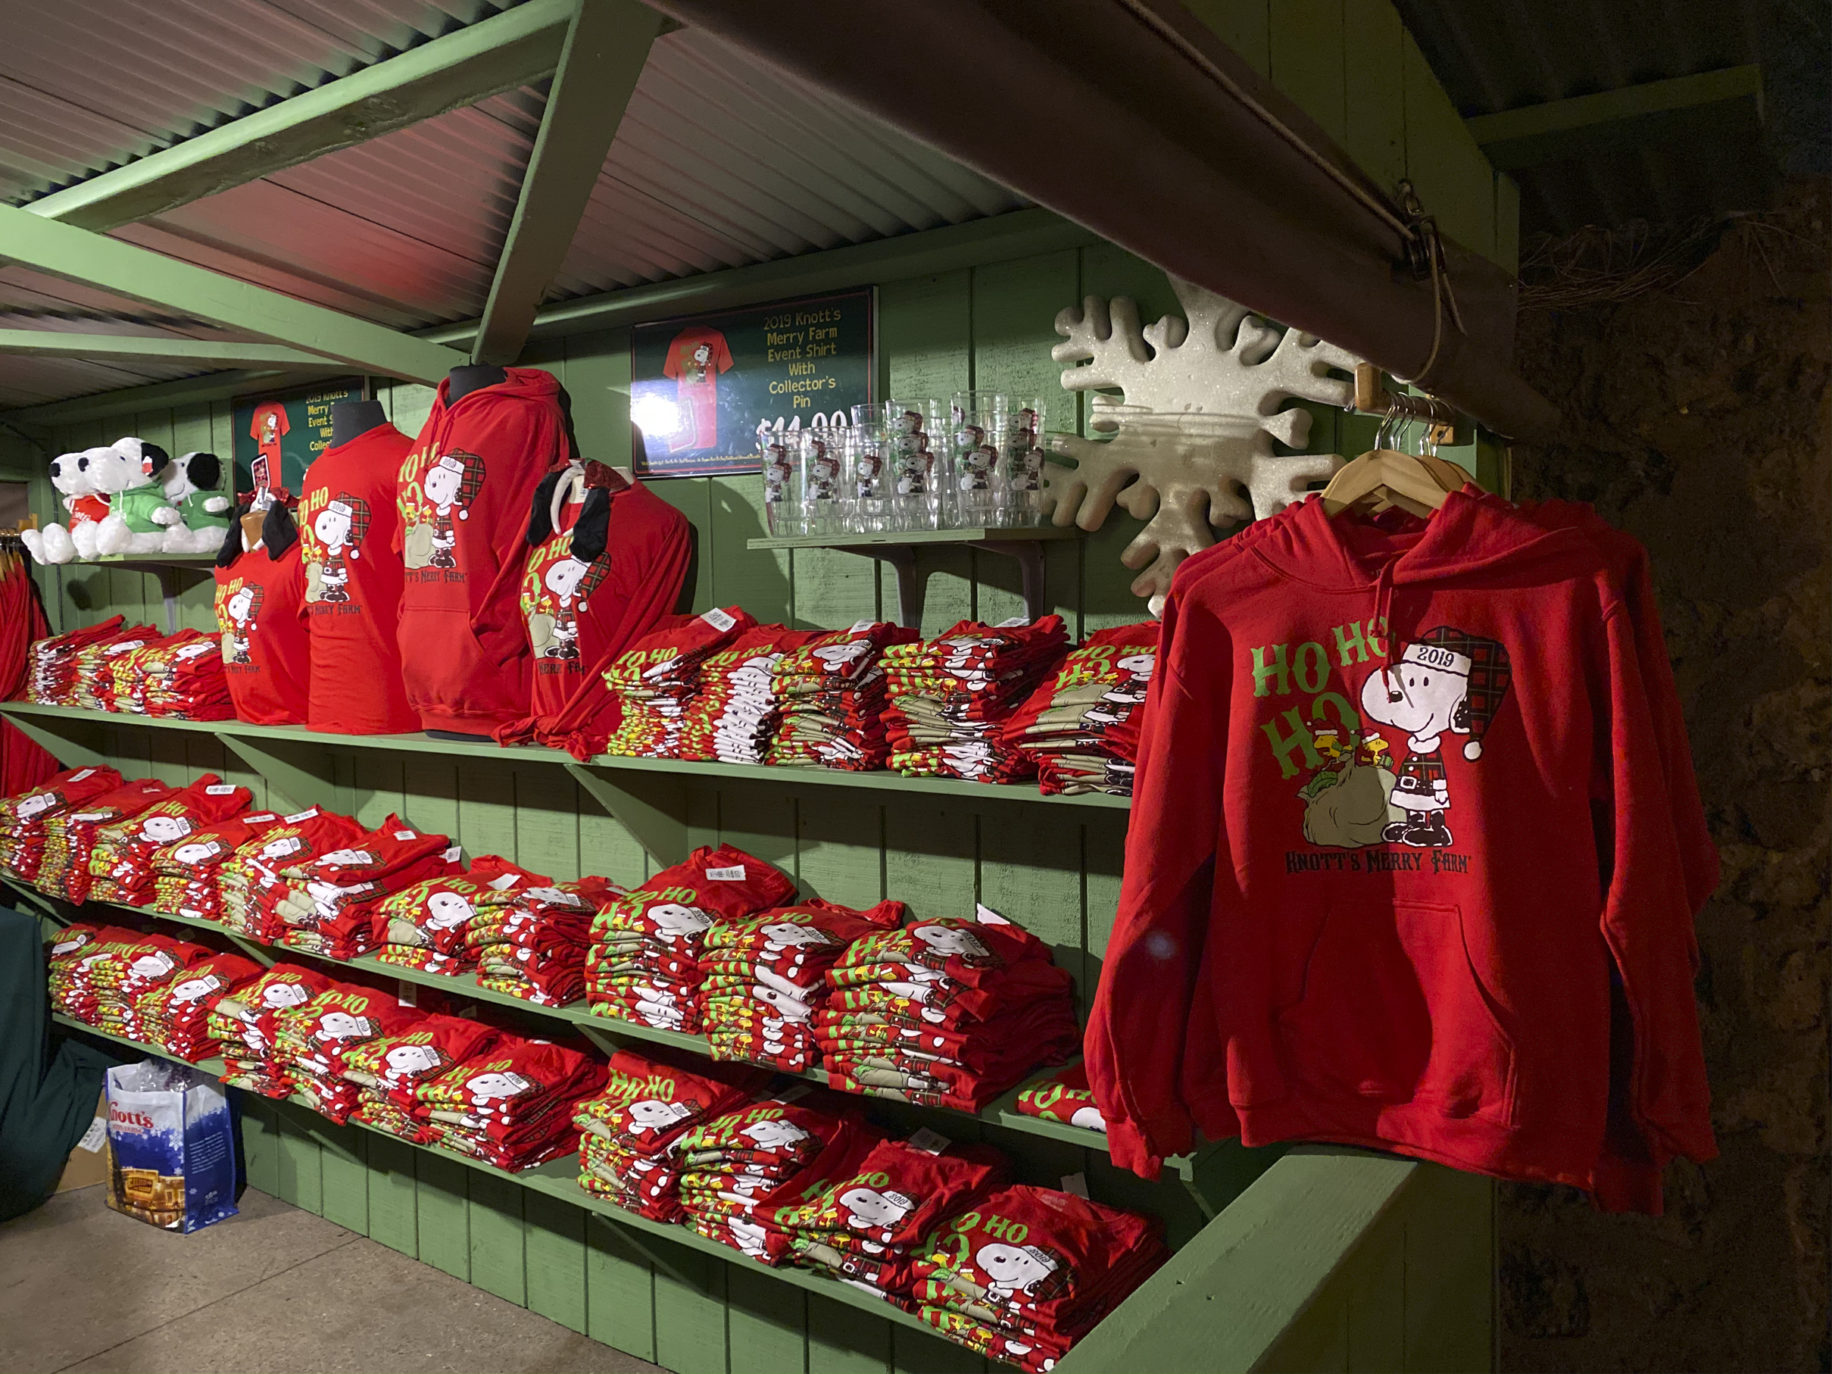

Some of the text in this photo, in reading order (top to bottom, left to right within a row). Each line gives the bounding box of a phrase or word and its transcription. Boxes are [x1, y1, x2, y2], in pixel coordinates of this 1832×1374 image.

[763, 307, 842, 330] 2019 Knott's
[767, 326, 838, 346] Merry Farm
[767, 341, 837, 363] Event Shirt
[788, 361, 816, 377] With
[768, 376, 837, 395] Collector's
[307, 404, 328, 416] Merry
[793, 395, 811, 409] Pin
[308, 416, 328, 428] Event
[311, 486, 329, 512] HO
[227, 576, 244, 596] HO
[647, 646, 679, 665] HO
[1066, 644, 1117, 661] HO
[1250, 616, 1388, 698] HO HO
[1416, 645, 1455, 667] 2019
[1259, 691, 1361, 781] HO
[1284, 850, 1361, 875] KNOTT'S
[1364, 850, 1422, 875] MERRY
[442, 877, 478, 894] HO
[656, 886, 698, 905] HO
[643, 1074, 676, 1102] HO
[743, 1108, 785, 1124] HO
[847, 1171, 890, 1188] HO
[981, 1213, 1029, 1244] HO
[1027, 1248, 1051, 1263] 2019
